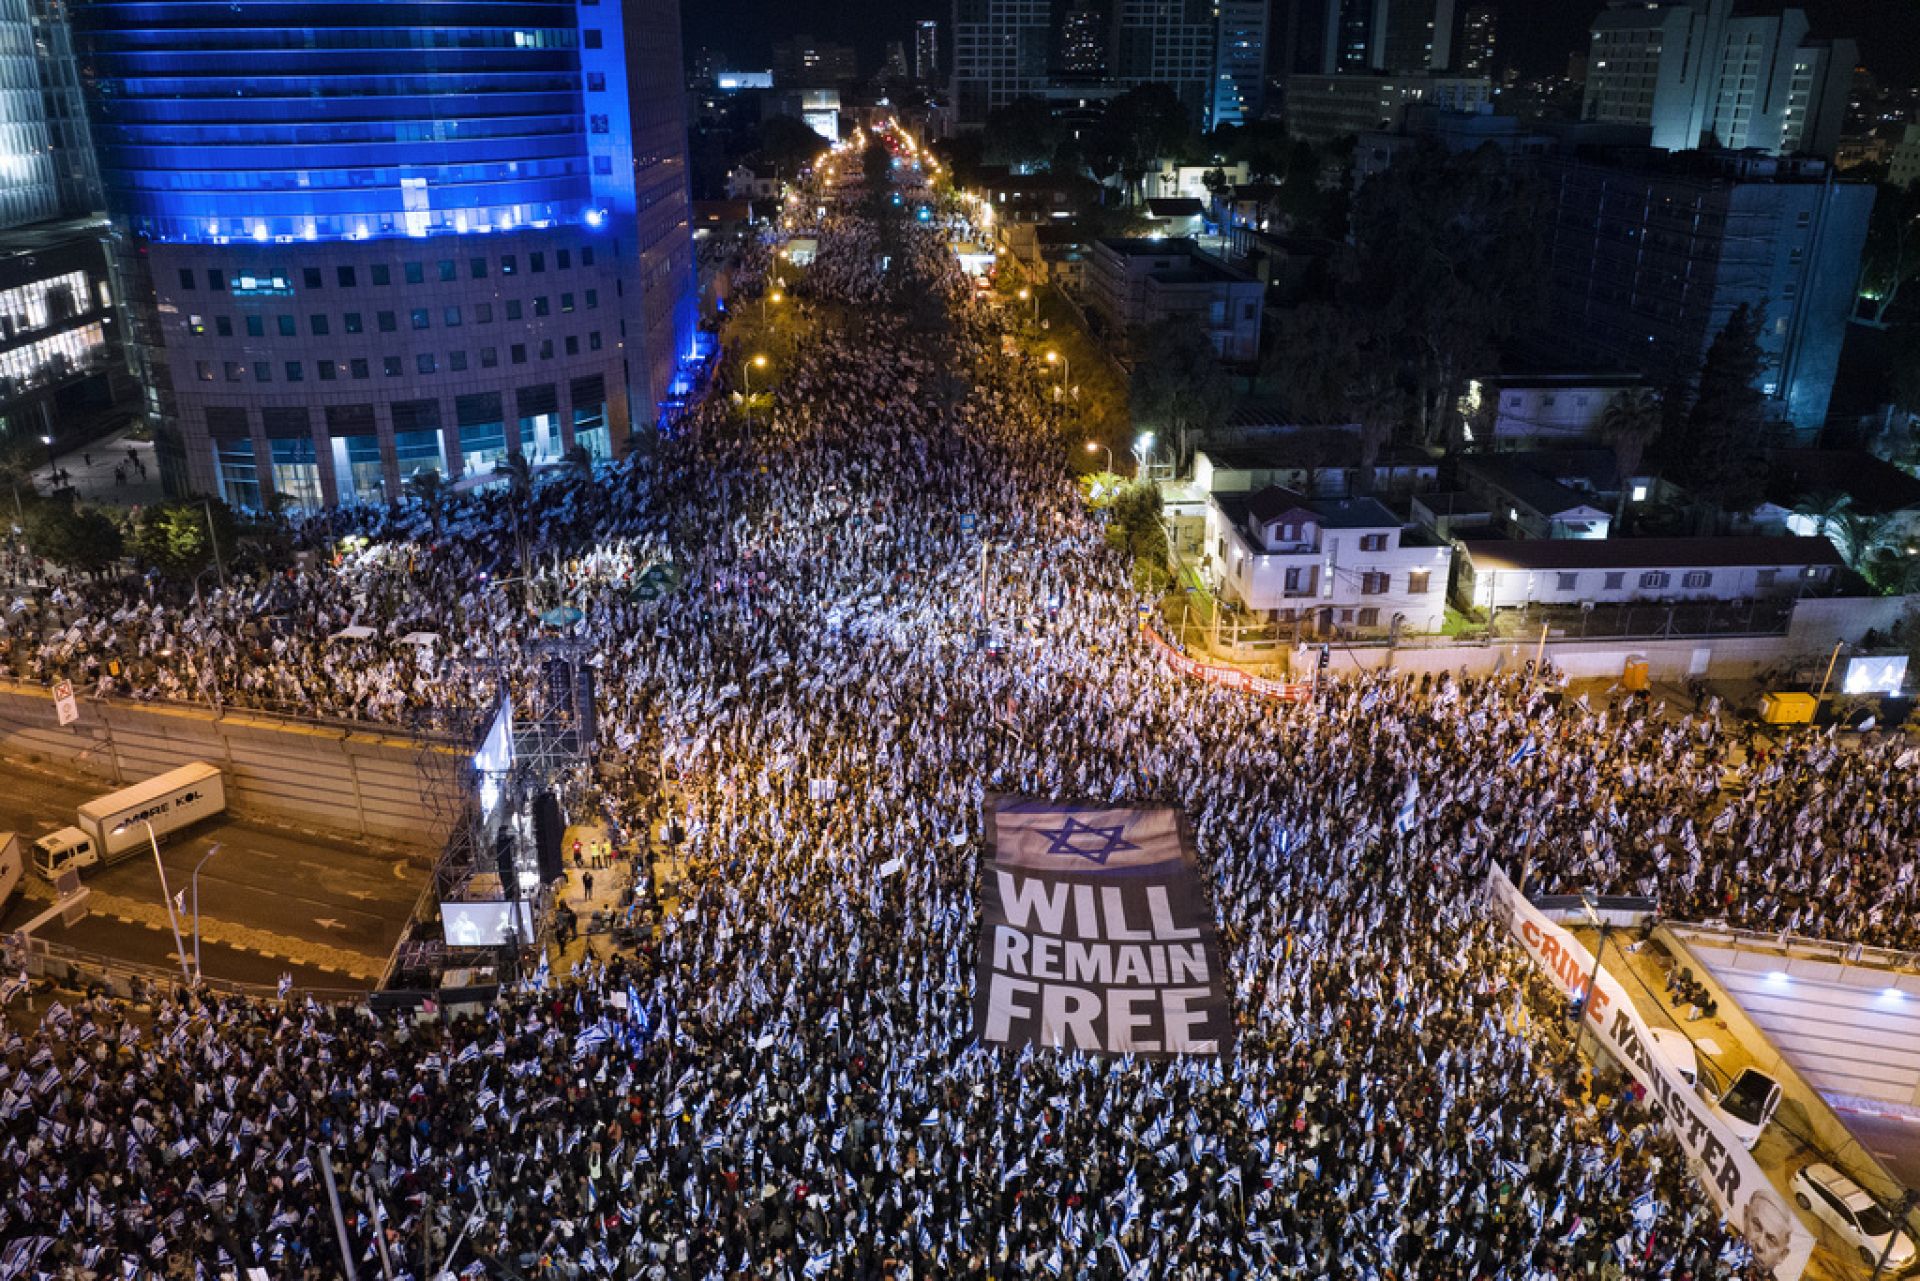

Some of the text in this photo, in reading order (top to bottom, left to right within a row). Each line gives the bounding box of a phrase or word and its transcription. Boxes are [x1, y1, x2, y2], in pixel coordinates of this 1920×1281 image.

[996, 869, 1201, 941] WILL
[993, 924, 1210, 984] REMAIN
[1521, 919, 1610, 1025] CRIME
[984, 972, 1220, 1055] FREE
